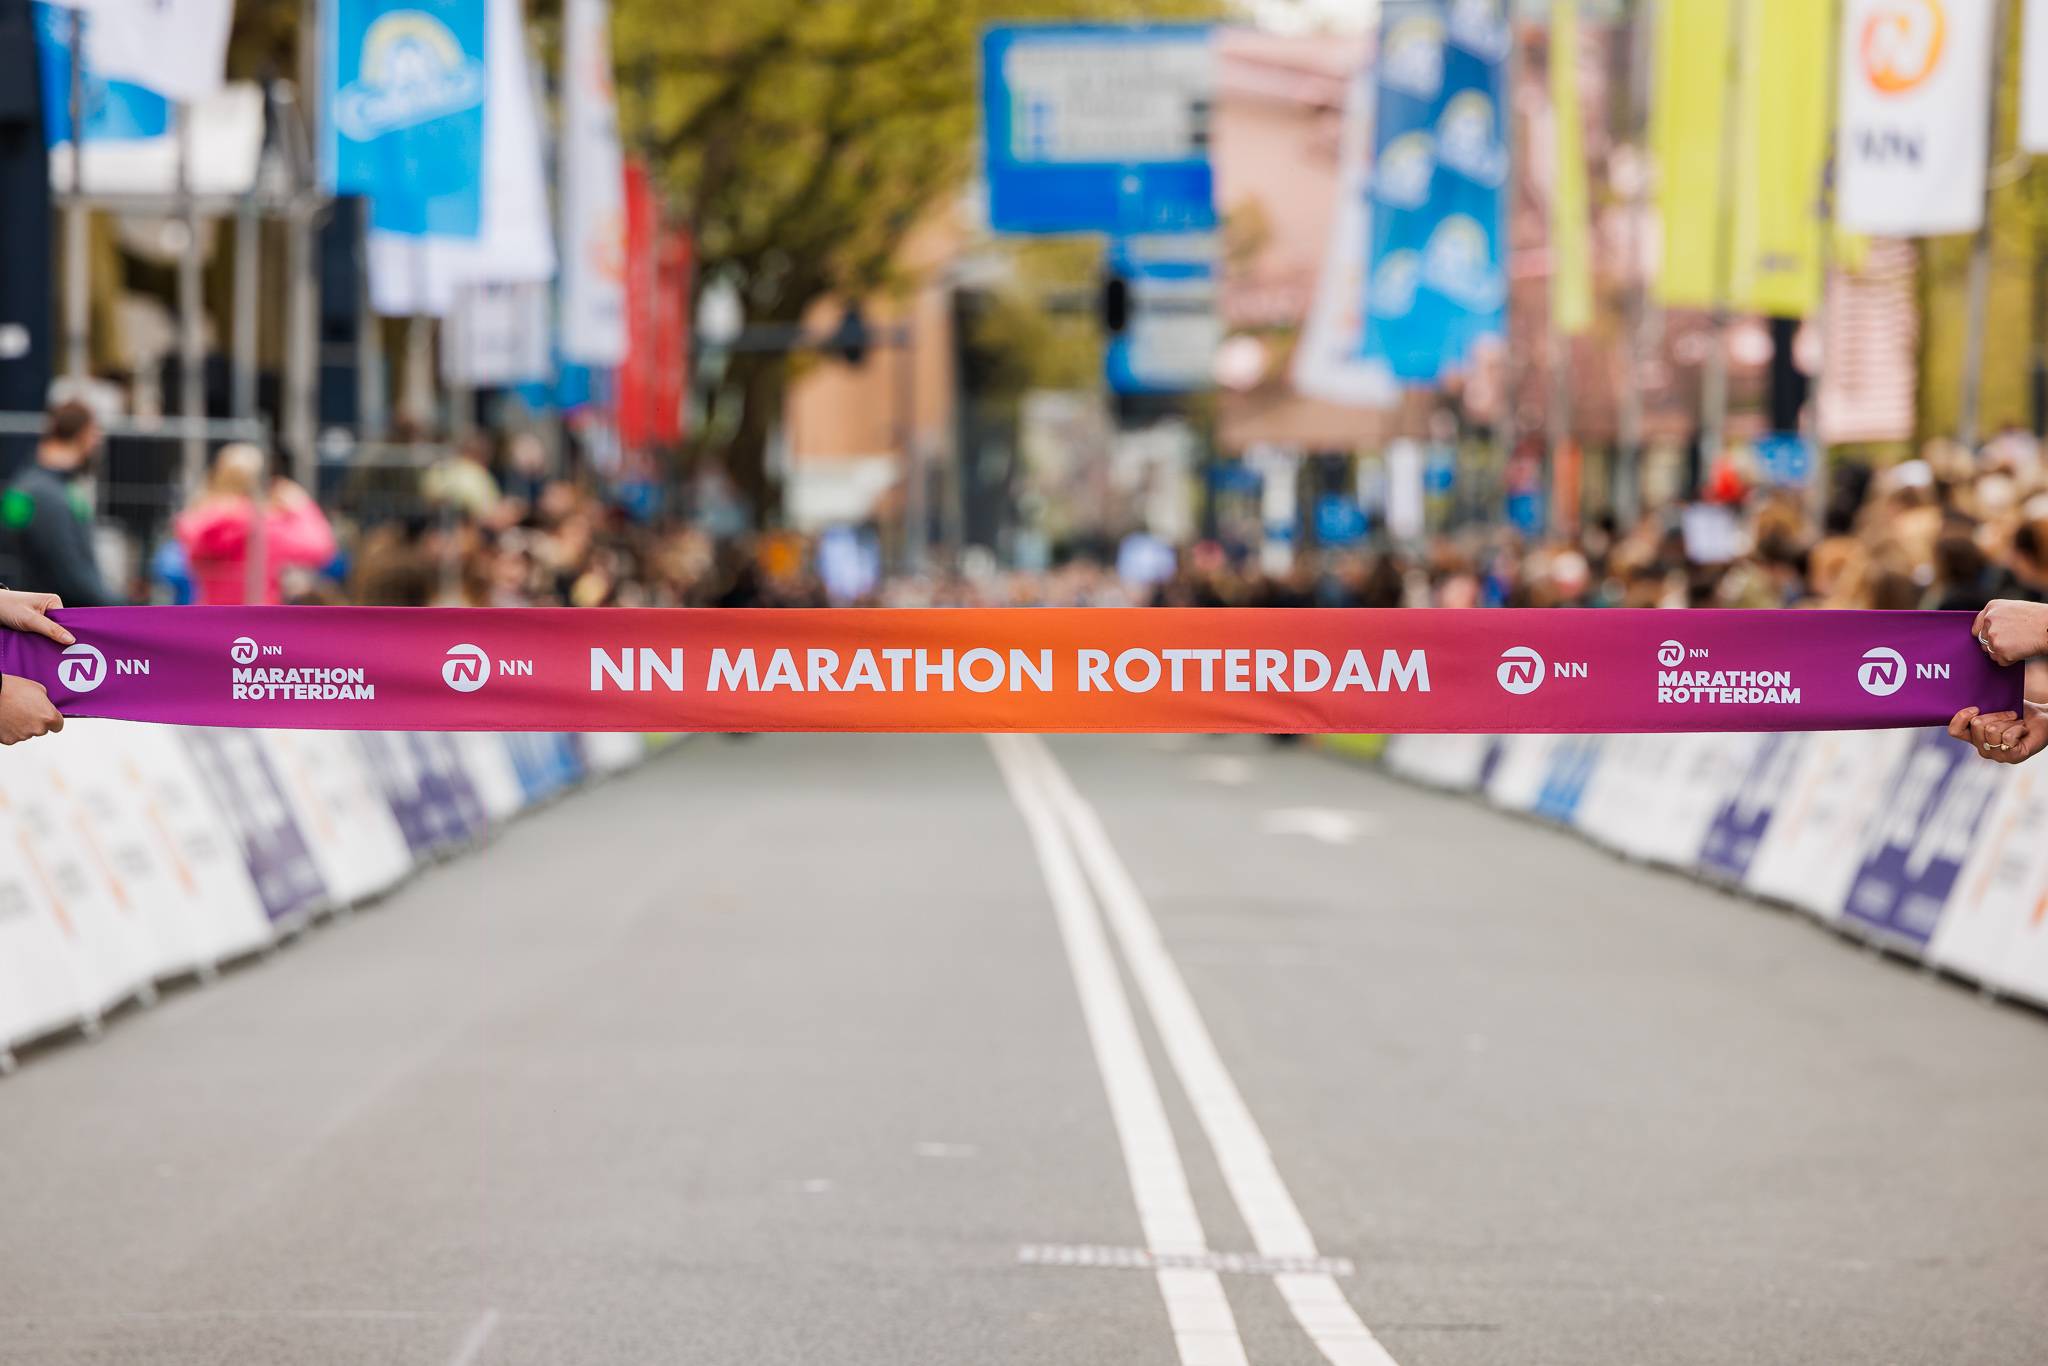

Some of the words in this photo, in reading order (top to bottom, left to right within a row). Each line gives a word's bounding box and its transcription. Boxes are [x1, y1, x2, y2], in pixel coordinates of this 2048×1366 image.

[262, 645, 282, 656] NN
[1689, 648, 1709, 658] NN
[115, 659, 150, 675] NN
[232, 667, 364, 684] MARATHON
[498, 659, 533, 676] NN
[590, 647, 684, 692] NN
[706, 648, 1053, 692] MARATHON
[1077, 648, 1431, 694] ROTTERDAM
[1553, 662, 1588, 679] NN
[1915, 663, 1950, 679] NN
[1657, 670, 1791, 688] MARATHON
[232, 683, 375, 700] ROTTERDAM
[1657, 687, 1801, 704] ROTTERDAM
